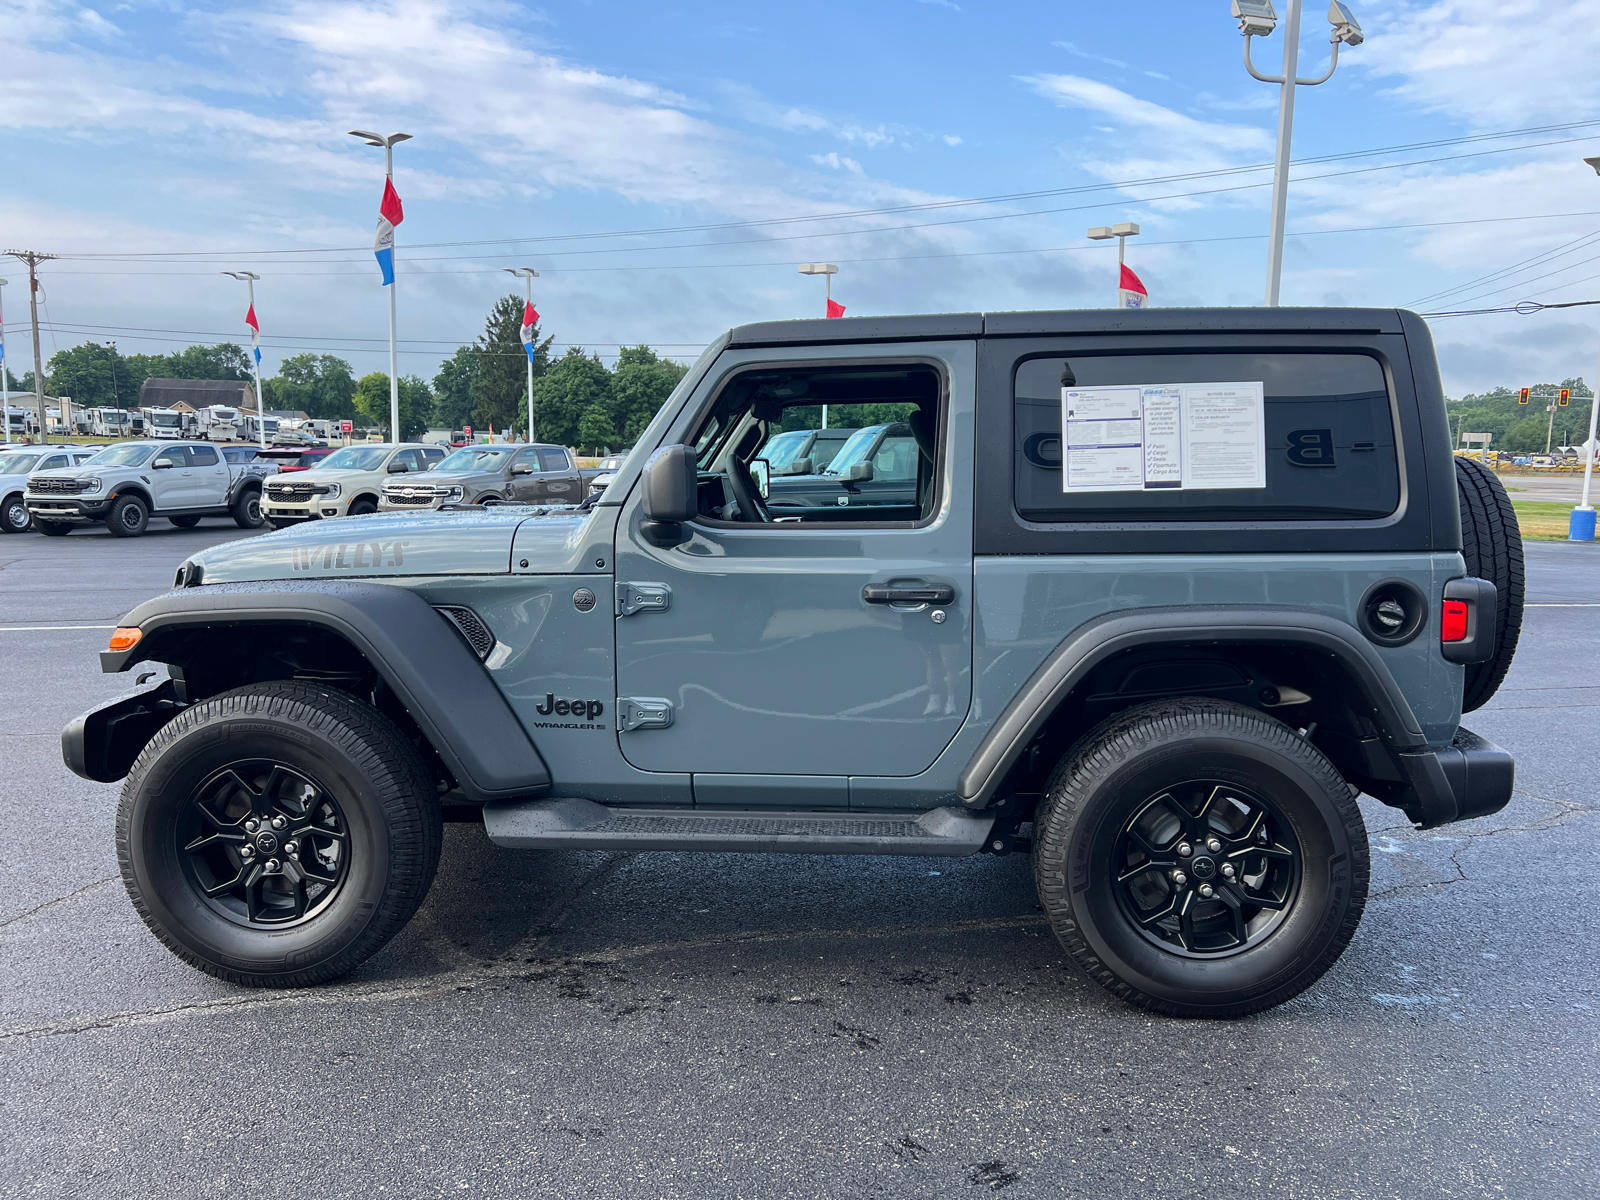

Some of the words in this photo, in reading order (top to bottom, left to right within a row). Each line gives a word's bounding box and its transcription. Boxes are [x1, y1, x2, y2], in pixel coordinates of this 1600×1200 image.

[291, 541, 410, 571] WILLYS
[535, 692, 604, 721] Jeep
[234, 724, 274, 732] DEFENDER
[533, 721, 595, 730] WRANGLER
